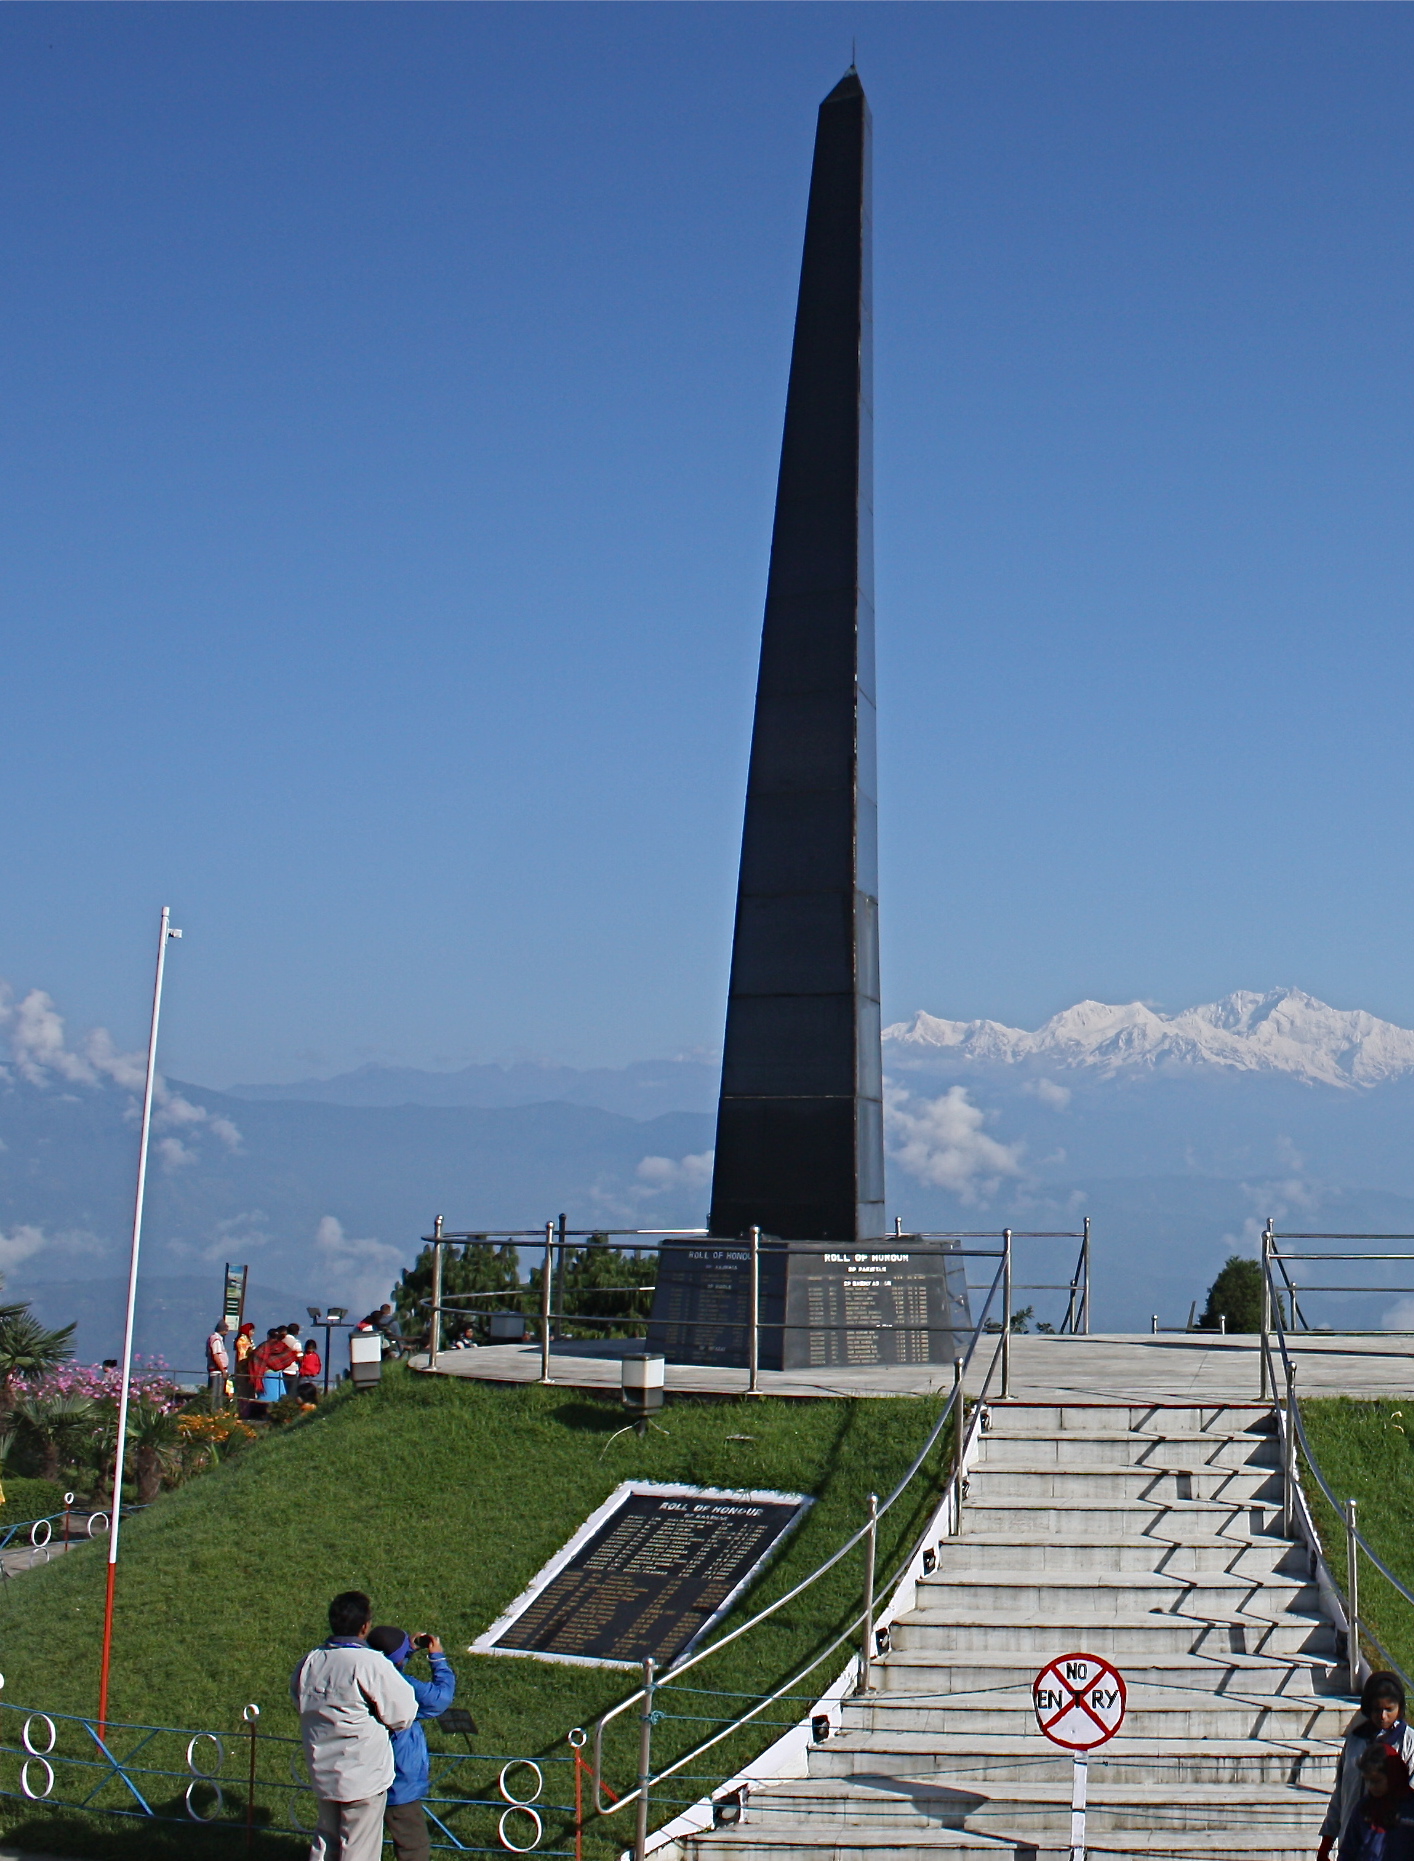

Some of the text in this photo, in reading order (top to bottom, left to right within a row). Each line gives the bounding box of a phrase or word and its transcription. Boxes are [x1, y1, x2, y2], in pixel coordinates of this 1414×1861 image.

[688, 1251, 709, 1259] ROLL
[824, 1254, 851, 1262] ROLL
[659, 1501, 764, 1518] ROLL OF HONOUR
[1066, 1662, 1088, 1680] NO
[1037, 1689, 1120, 1710] ENTRY
